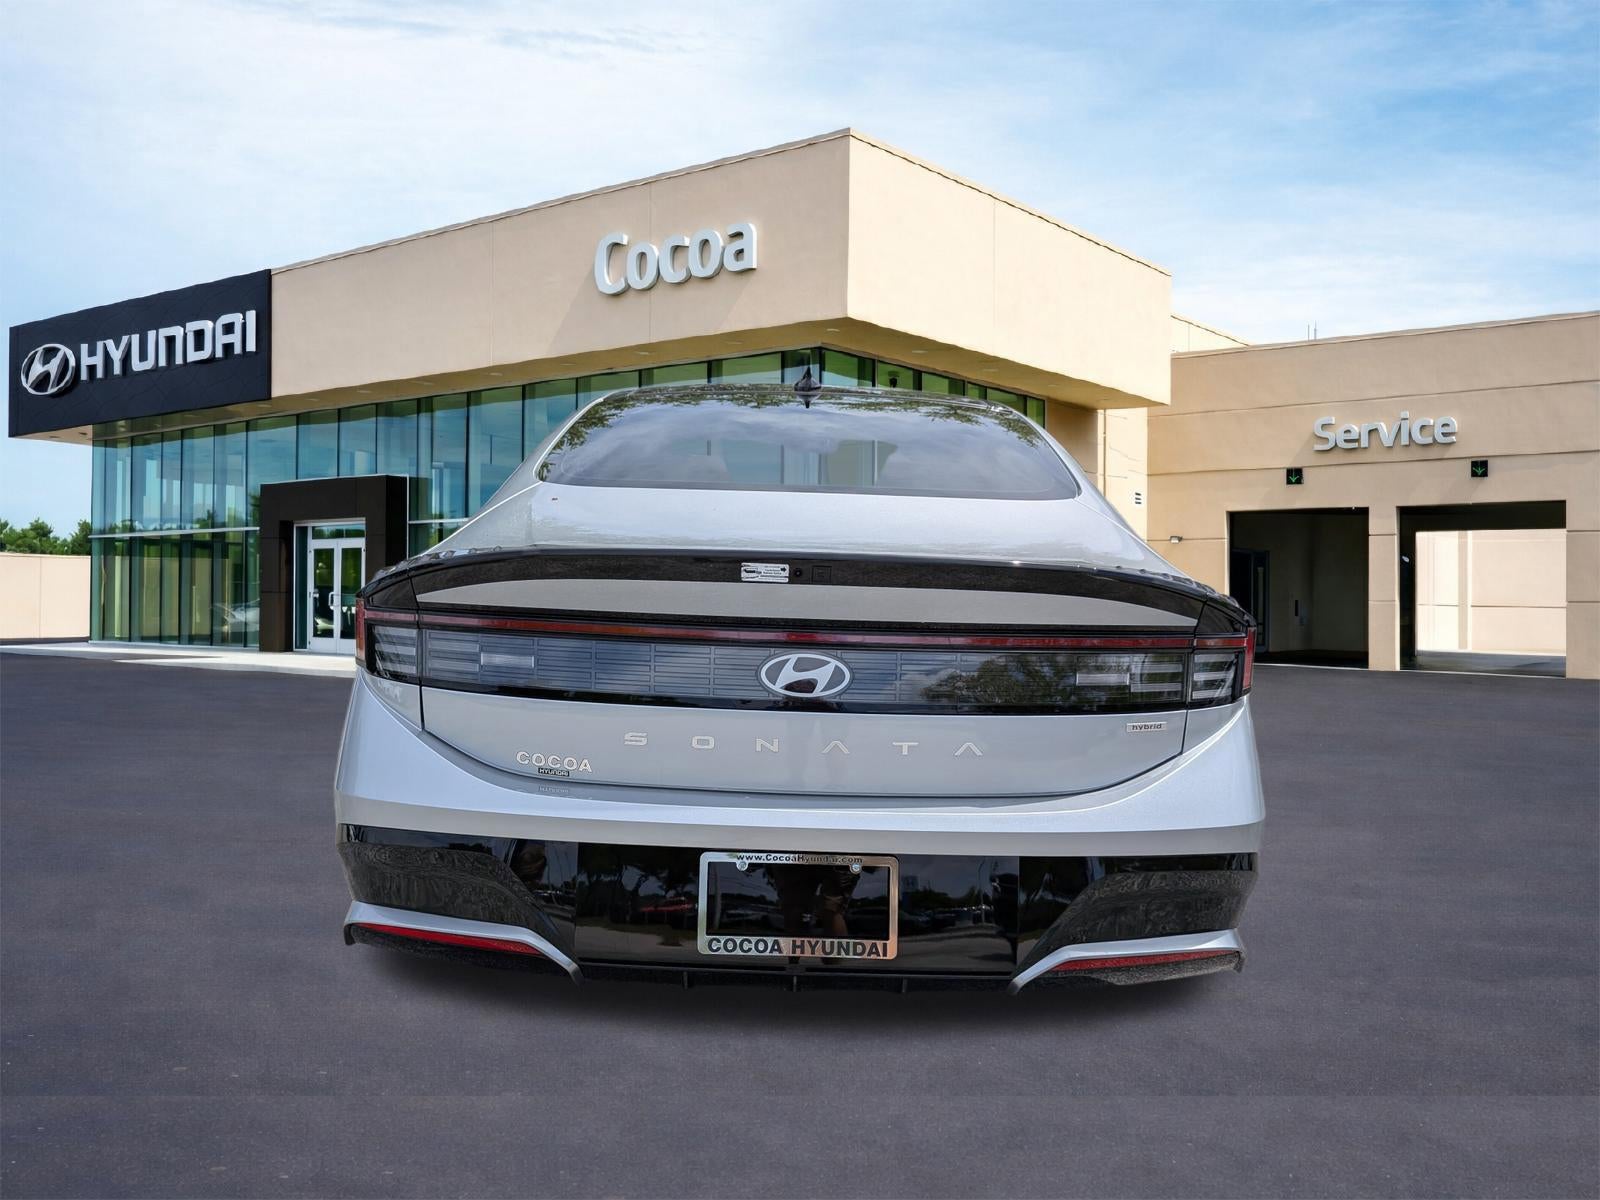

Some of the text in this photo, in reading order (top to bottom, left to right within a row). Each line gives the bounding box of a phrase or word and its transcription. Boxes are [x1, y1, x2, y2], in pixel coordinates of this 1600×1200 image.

[594, 222, 758, 296] Cocoa
[79, 310, 257, 382] HYUNDAI
[1313, 411, 1459, 452] Service
[1131, 723, 1162, 731] hybrid
[516, 751, 592, 773] COCOA
[736, 853, 863, 864] www.CocoaHyundai.com
[707, 937, 888, 958] COCOA HYUNDAI
